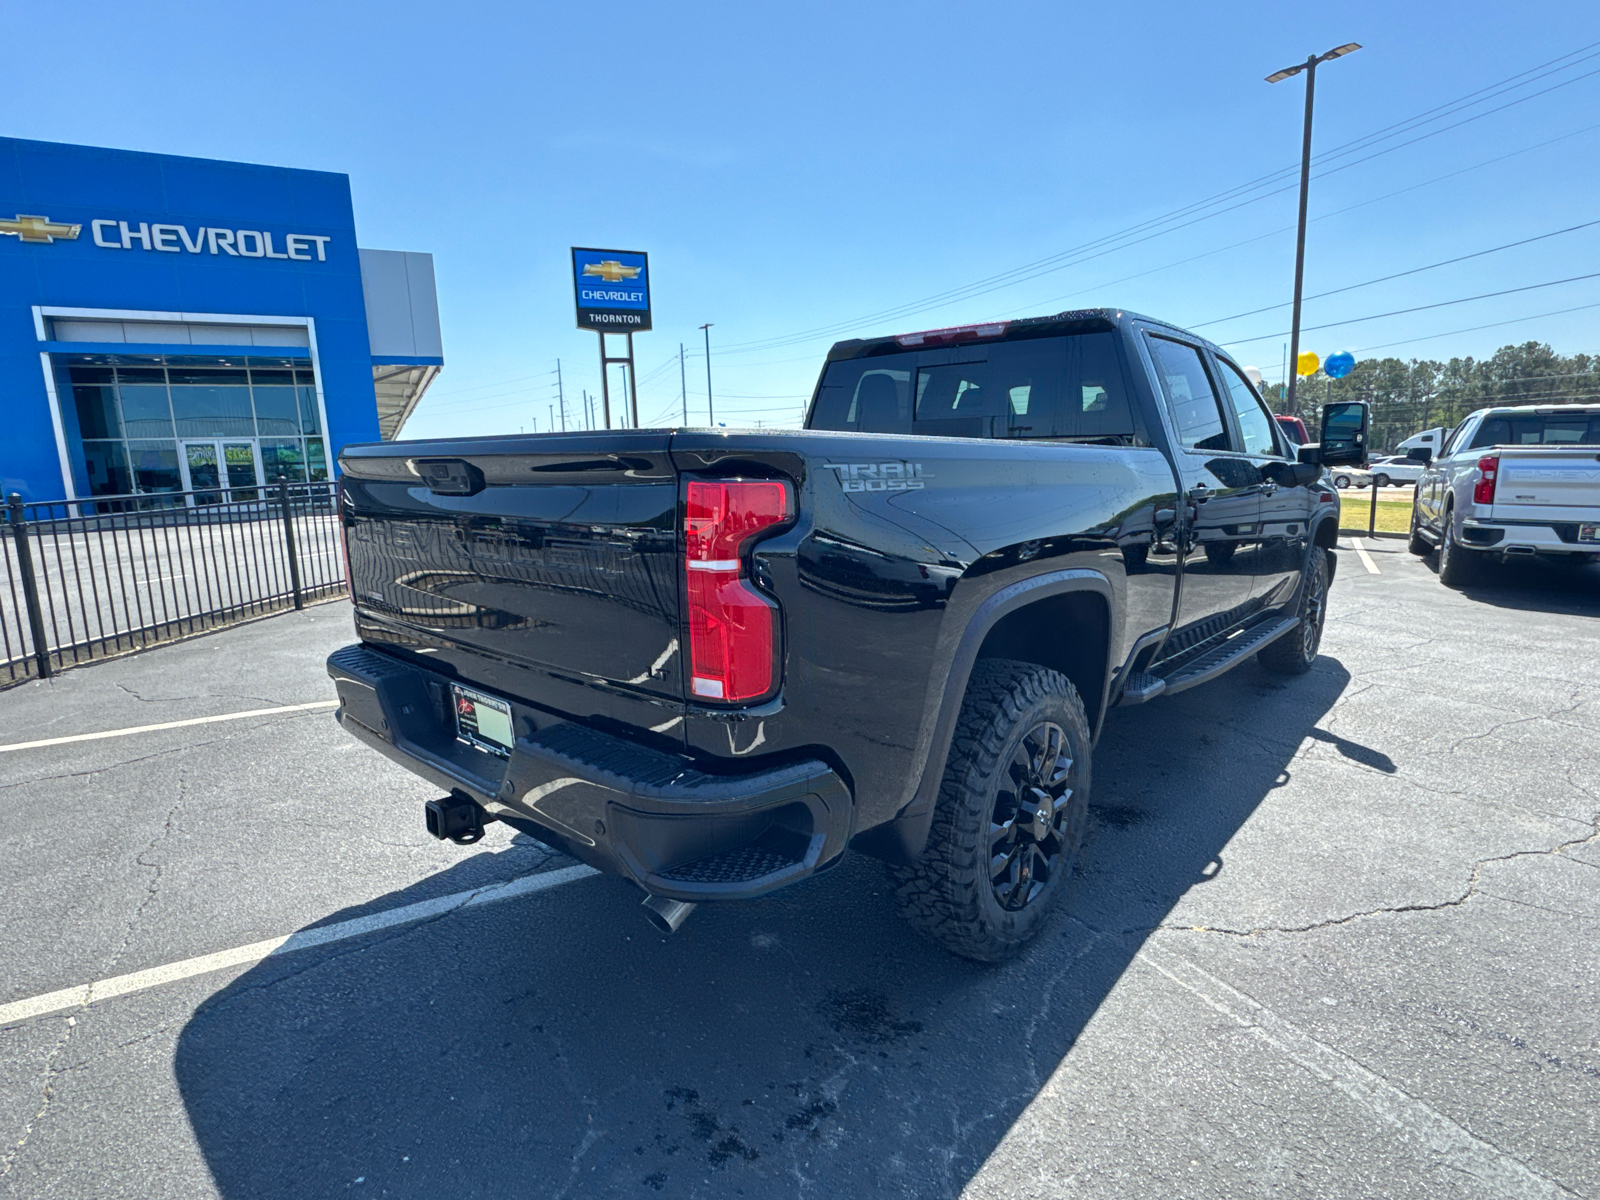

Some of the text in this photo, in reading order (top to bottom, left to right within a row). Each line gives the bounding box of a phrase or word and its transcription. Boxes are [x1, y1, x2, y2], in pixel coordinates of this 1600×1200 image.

[91, 218, 331, 263] CHEVROLET
[582, 290, 644, 302] CHEVROLET
[589, 313, 641, 324] THORNTON
[823, 463, 935, 479] TRAIL
[843, 479, 925, 493] BOSS
[355, 521, 633, 580] CHEVROLET
[646, 666, 670, 682] LT
